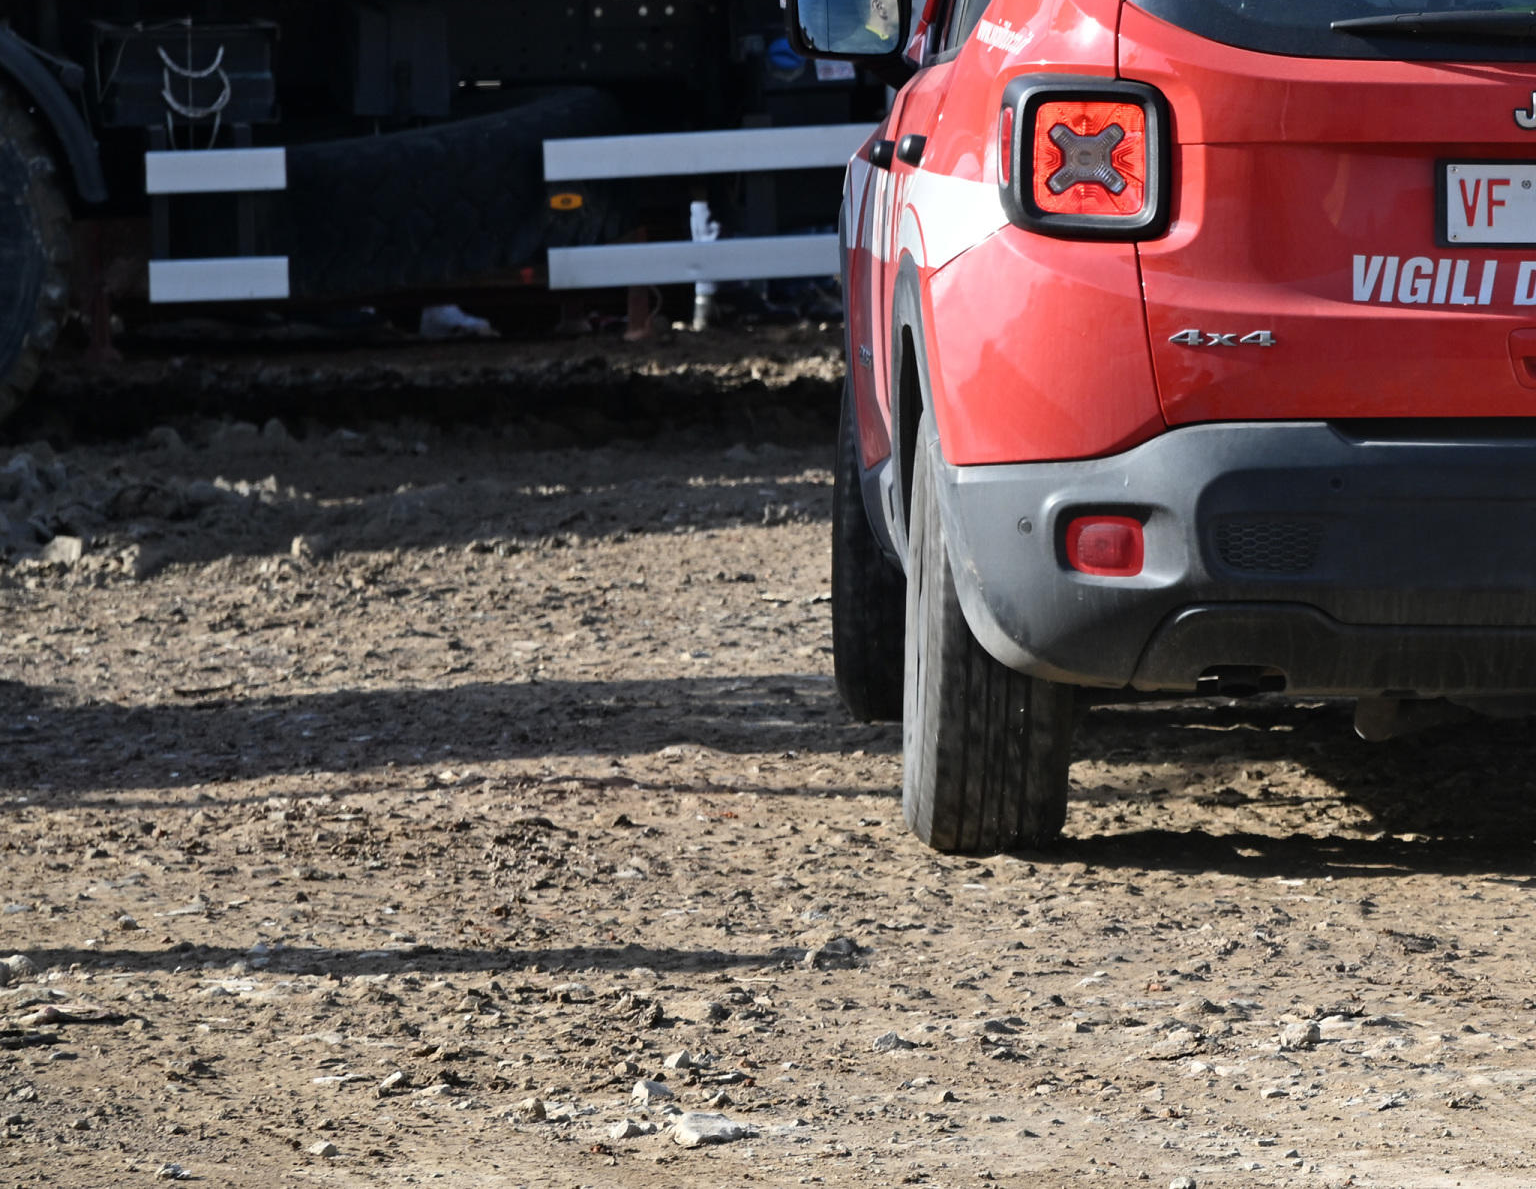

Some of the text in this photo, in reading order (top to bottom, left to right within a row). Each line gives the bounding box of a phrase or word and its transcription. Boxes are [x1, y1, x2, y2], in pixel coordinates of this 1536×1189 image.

[1458, 178, 1511, 228] VF
[1350, 254, 1495, 306] VIGILI
[1167, 328, 1277, 347] 4x4
